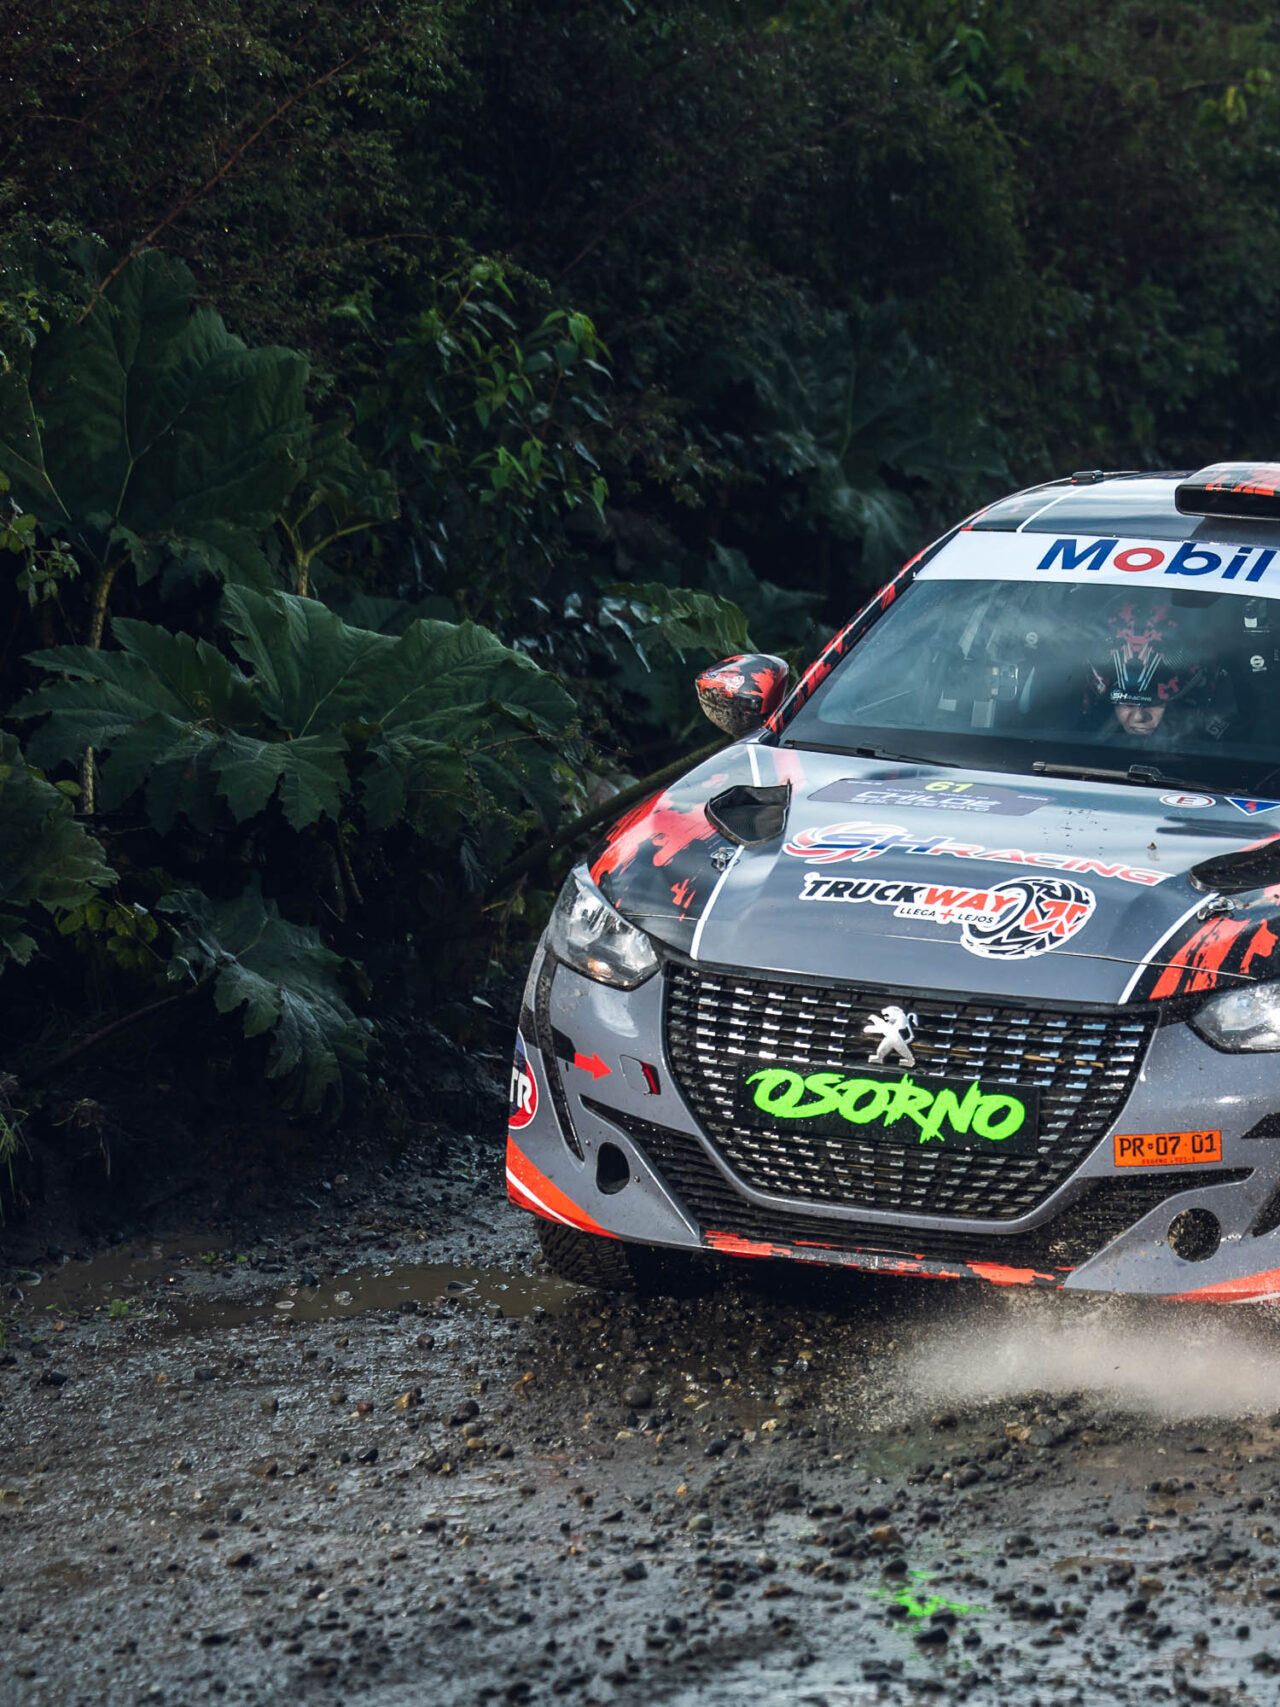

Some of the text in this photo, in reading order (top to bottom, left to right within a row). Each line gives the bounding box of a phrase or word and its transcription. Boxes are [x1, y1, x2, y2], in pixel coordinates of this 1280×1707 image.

[1036, 538, 1277, 583] Mobil
[925, 781, 974, 793] 61
[1176, 796, 1198, 806] E
[806, 880, 1021, 913] TRUCKWAY
[899, 907, 935, 918] LLEGA
[957, 914, 995, 925] LEJOS
[745, 1068, 1026, 1144] OSORNO
